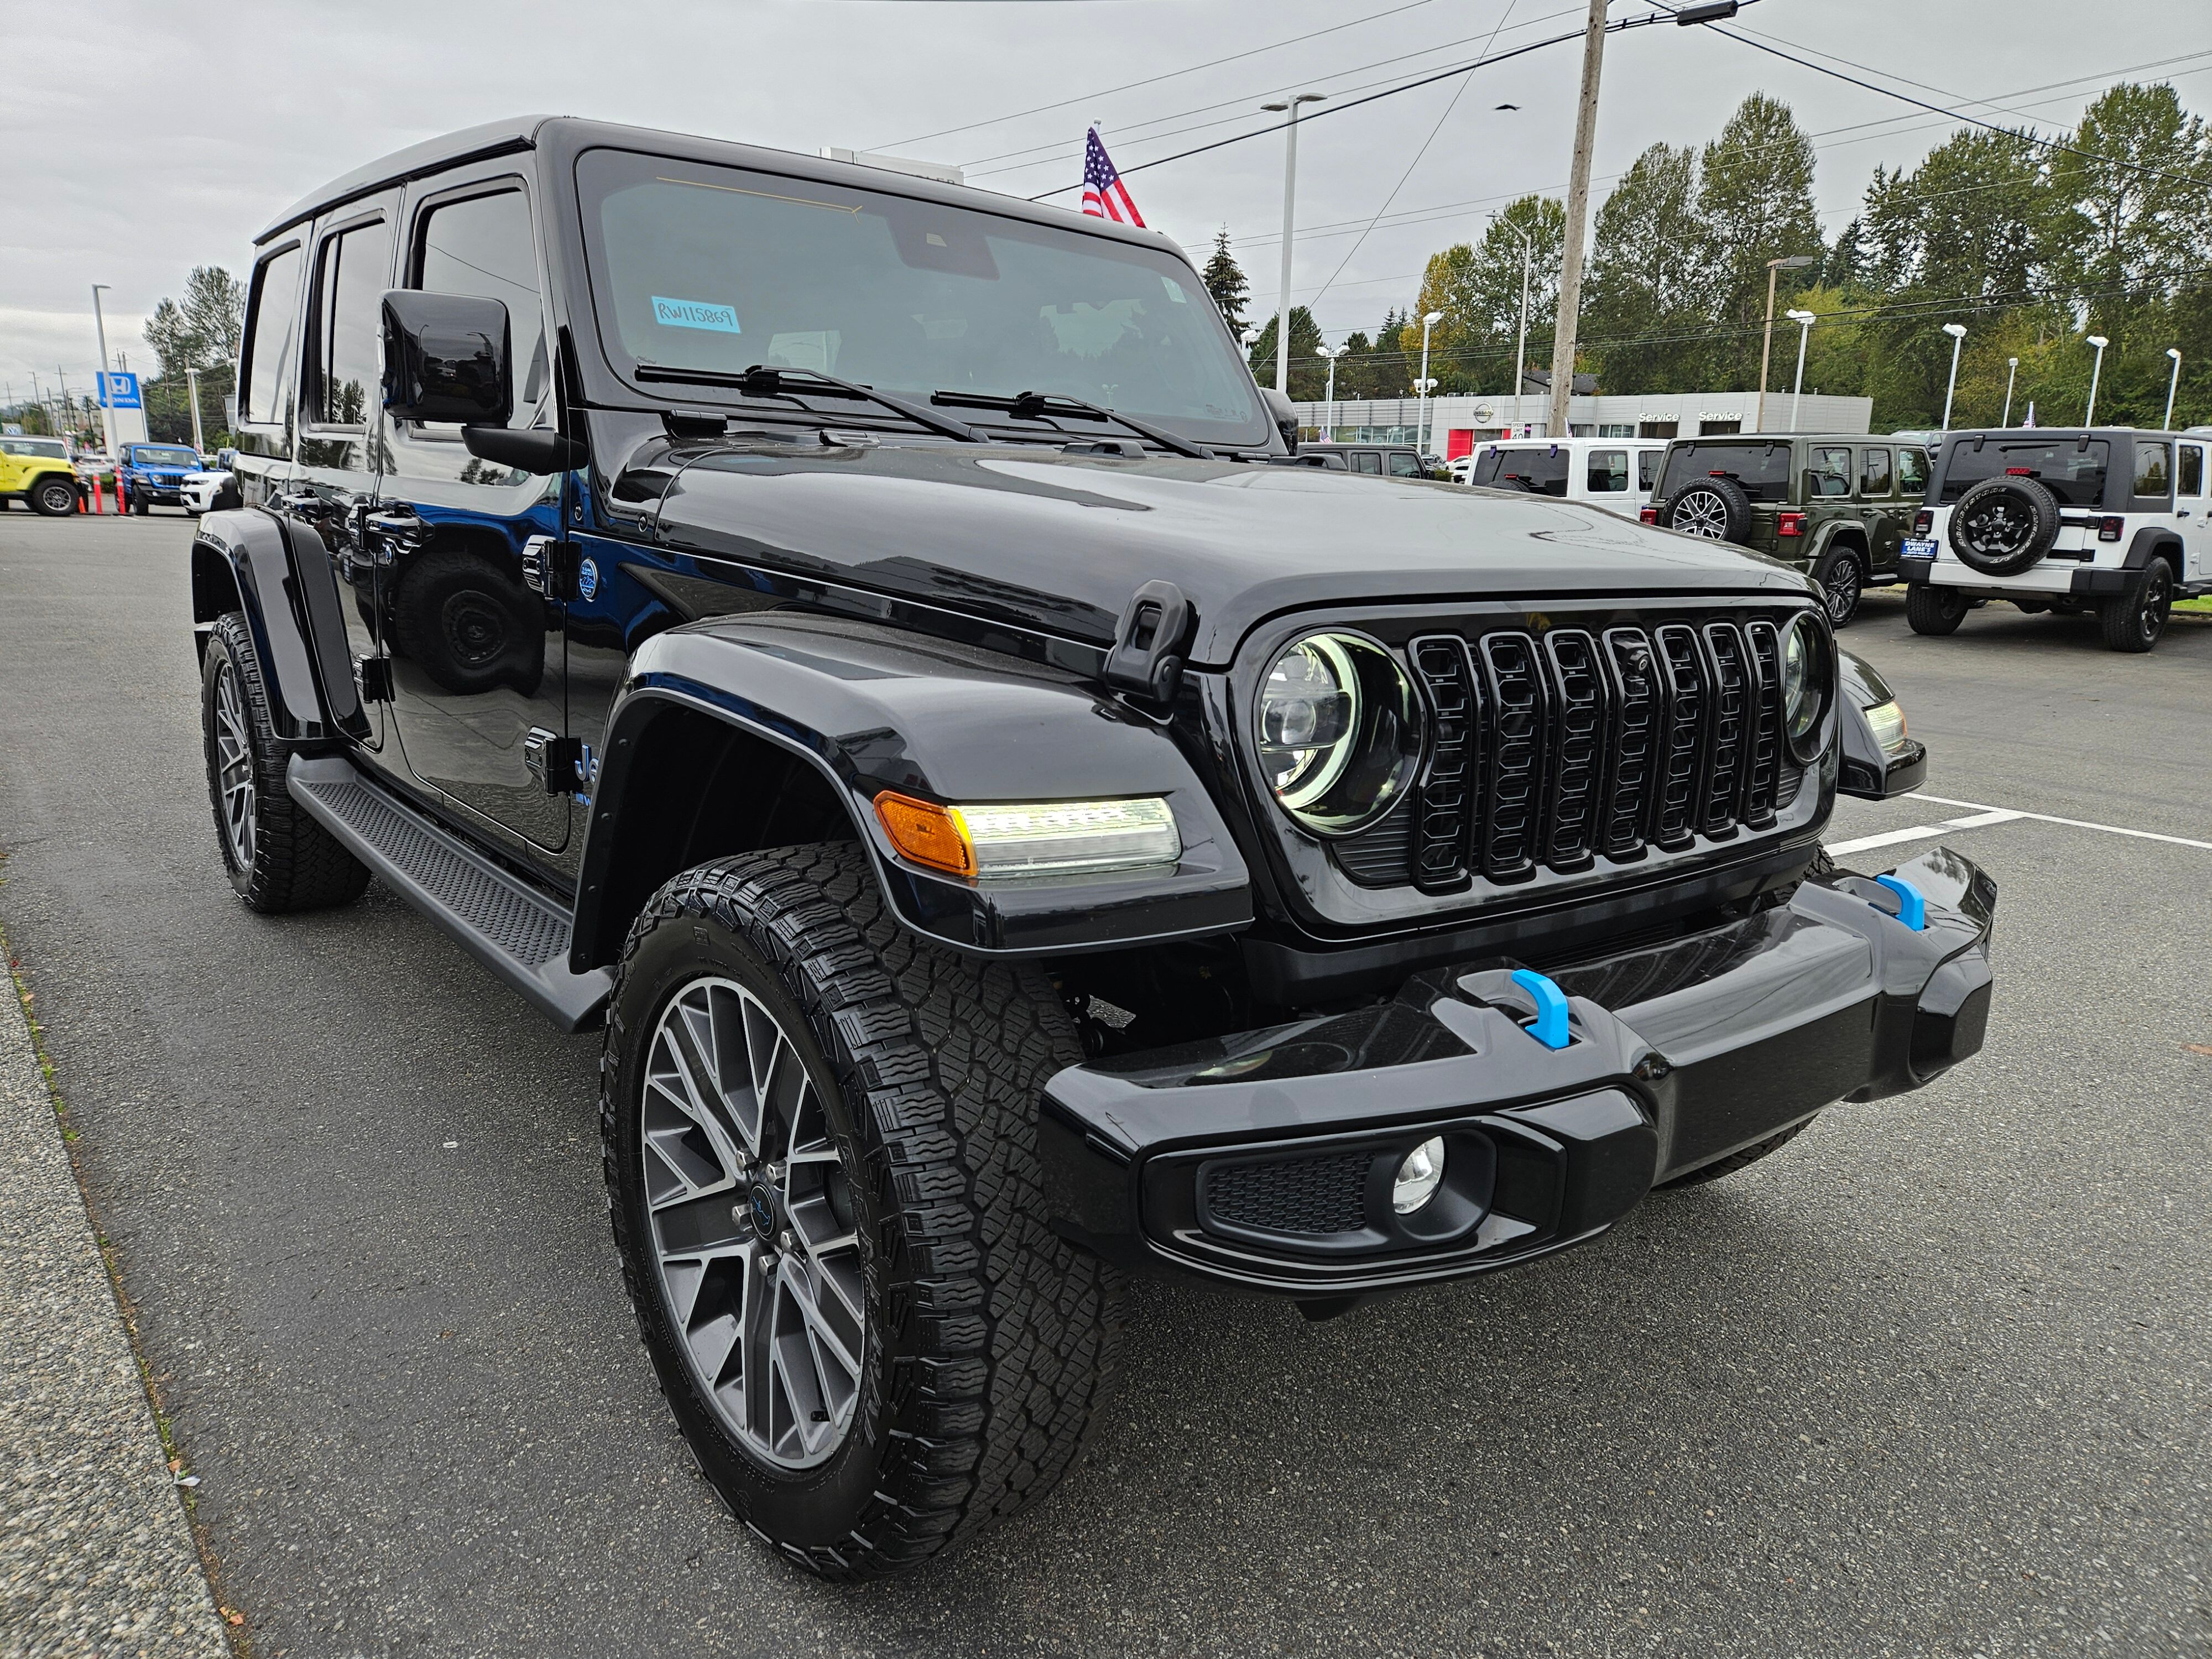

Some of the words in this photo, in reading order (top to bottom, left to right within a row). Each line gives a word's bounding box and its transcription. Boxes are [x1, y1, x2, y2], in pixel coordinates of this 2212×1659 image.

[658, 302, 733, 327] RW115869
[1638, 412, 1680, 422] Service
[1698, 411, 1743, 421] Service
[1955, 487, 2007, 547] BRIDGESTONE
[575, 744, 599, 785] Je
[602, 1091, 656, 1343] GRABBER
